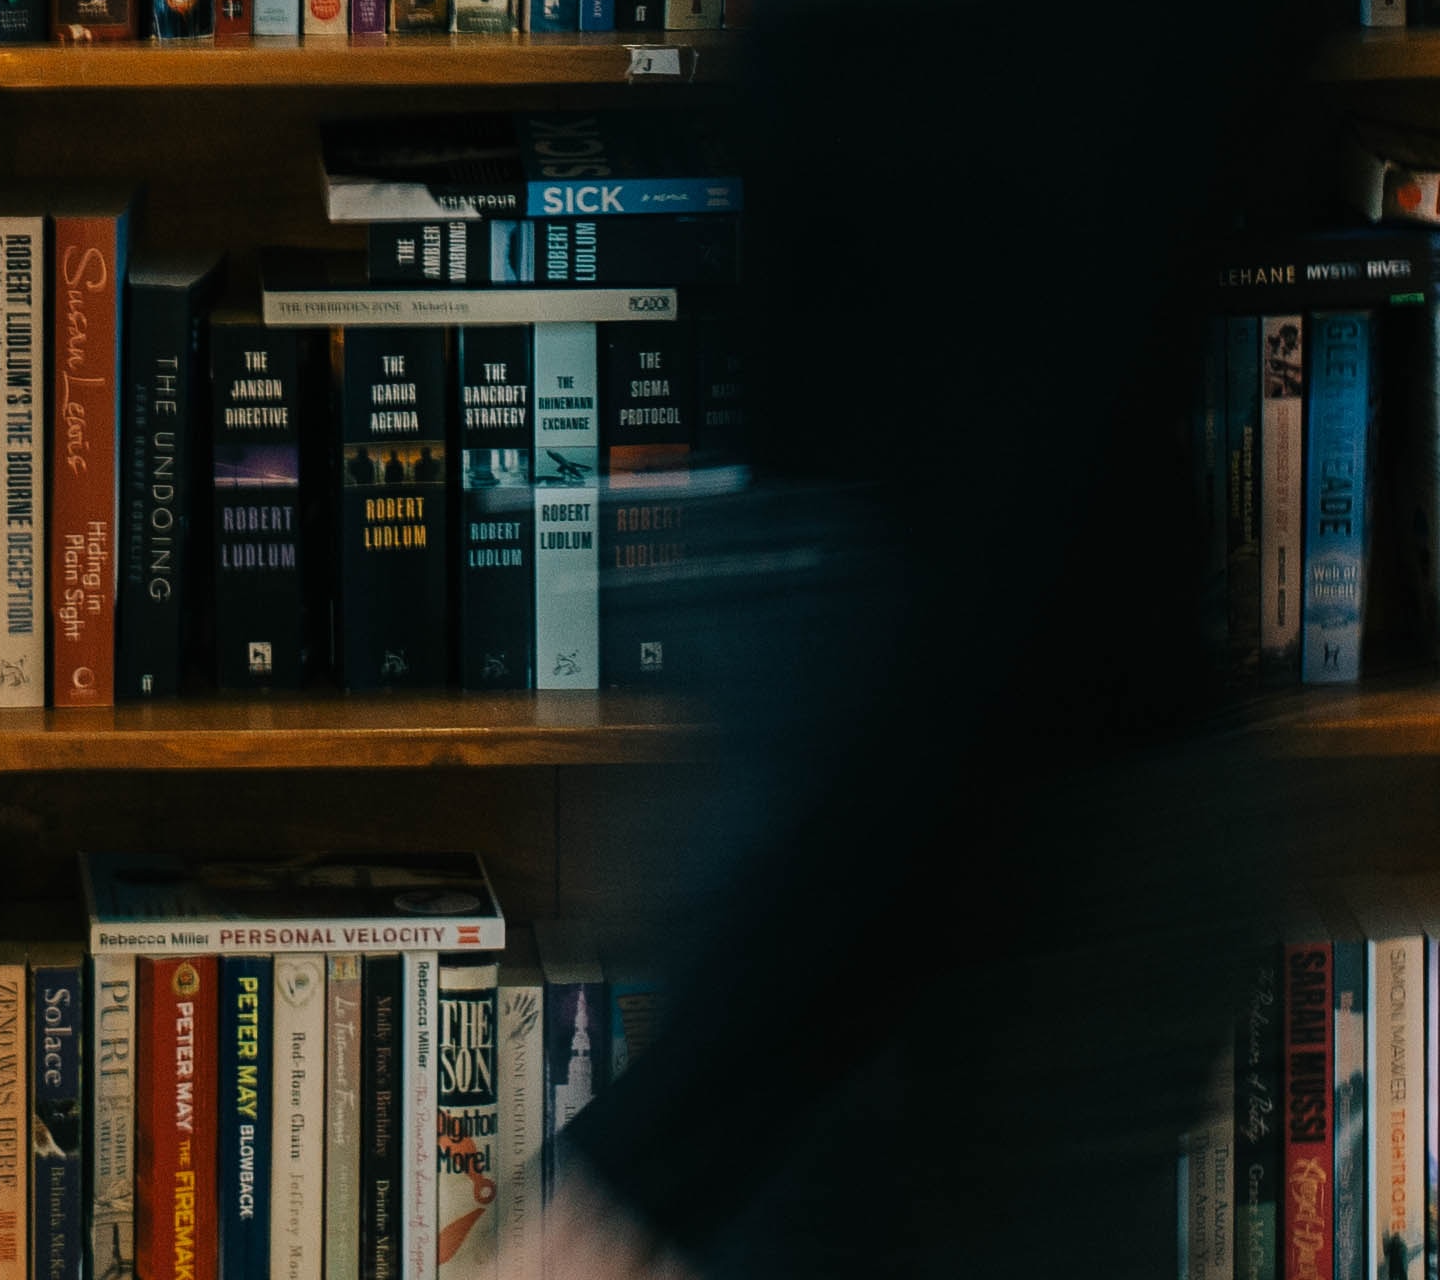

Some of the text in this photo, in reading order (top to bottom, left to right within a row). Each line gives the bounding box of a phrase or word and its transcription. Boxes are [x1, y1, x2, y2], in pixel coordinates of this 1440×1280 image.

[542, 185, 625, 214] SICK
[542, 504, 590, 523] ROBERT
[540, 532, 592, 550] LUDLUM
